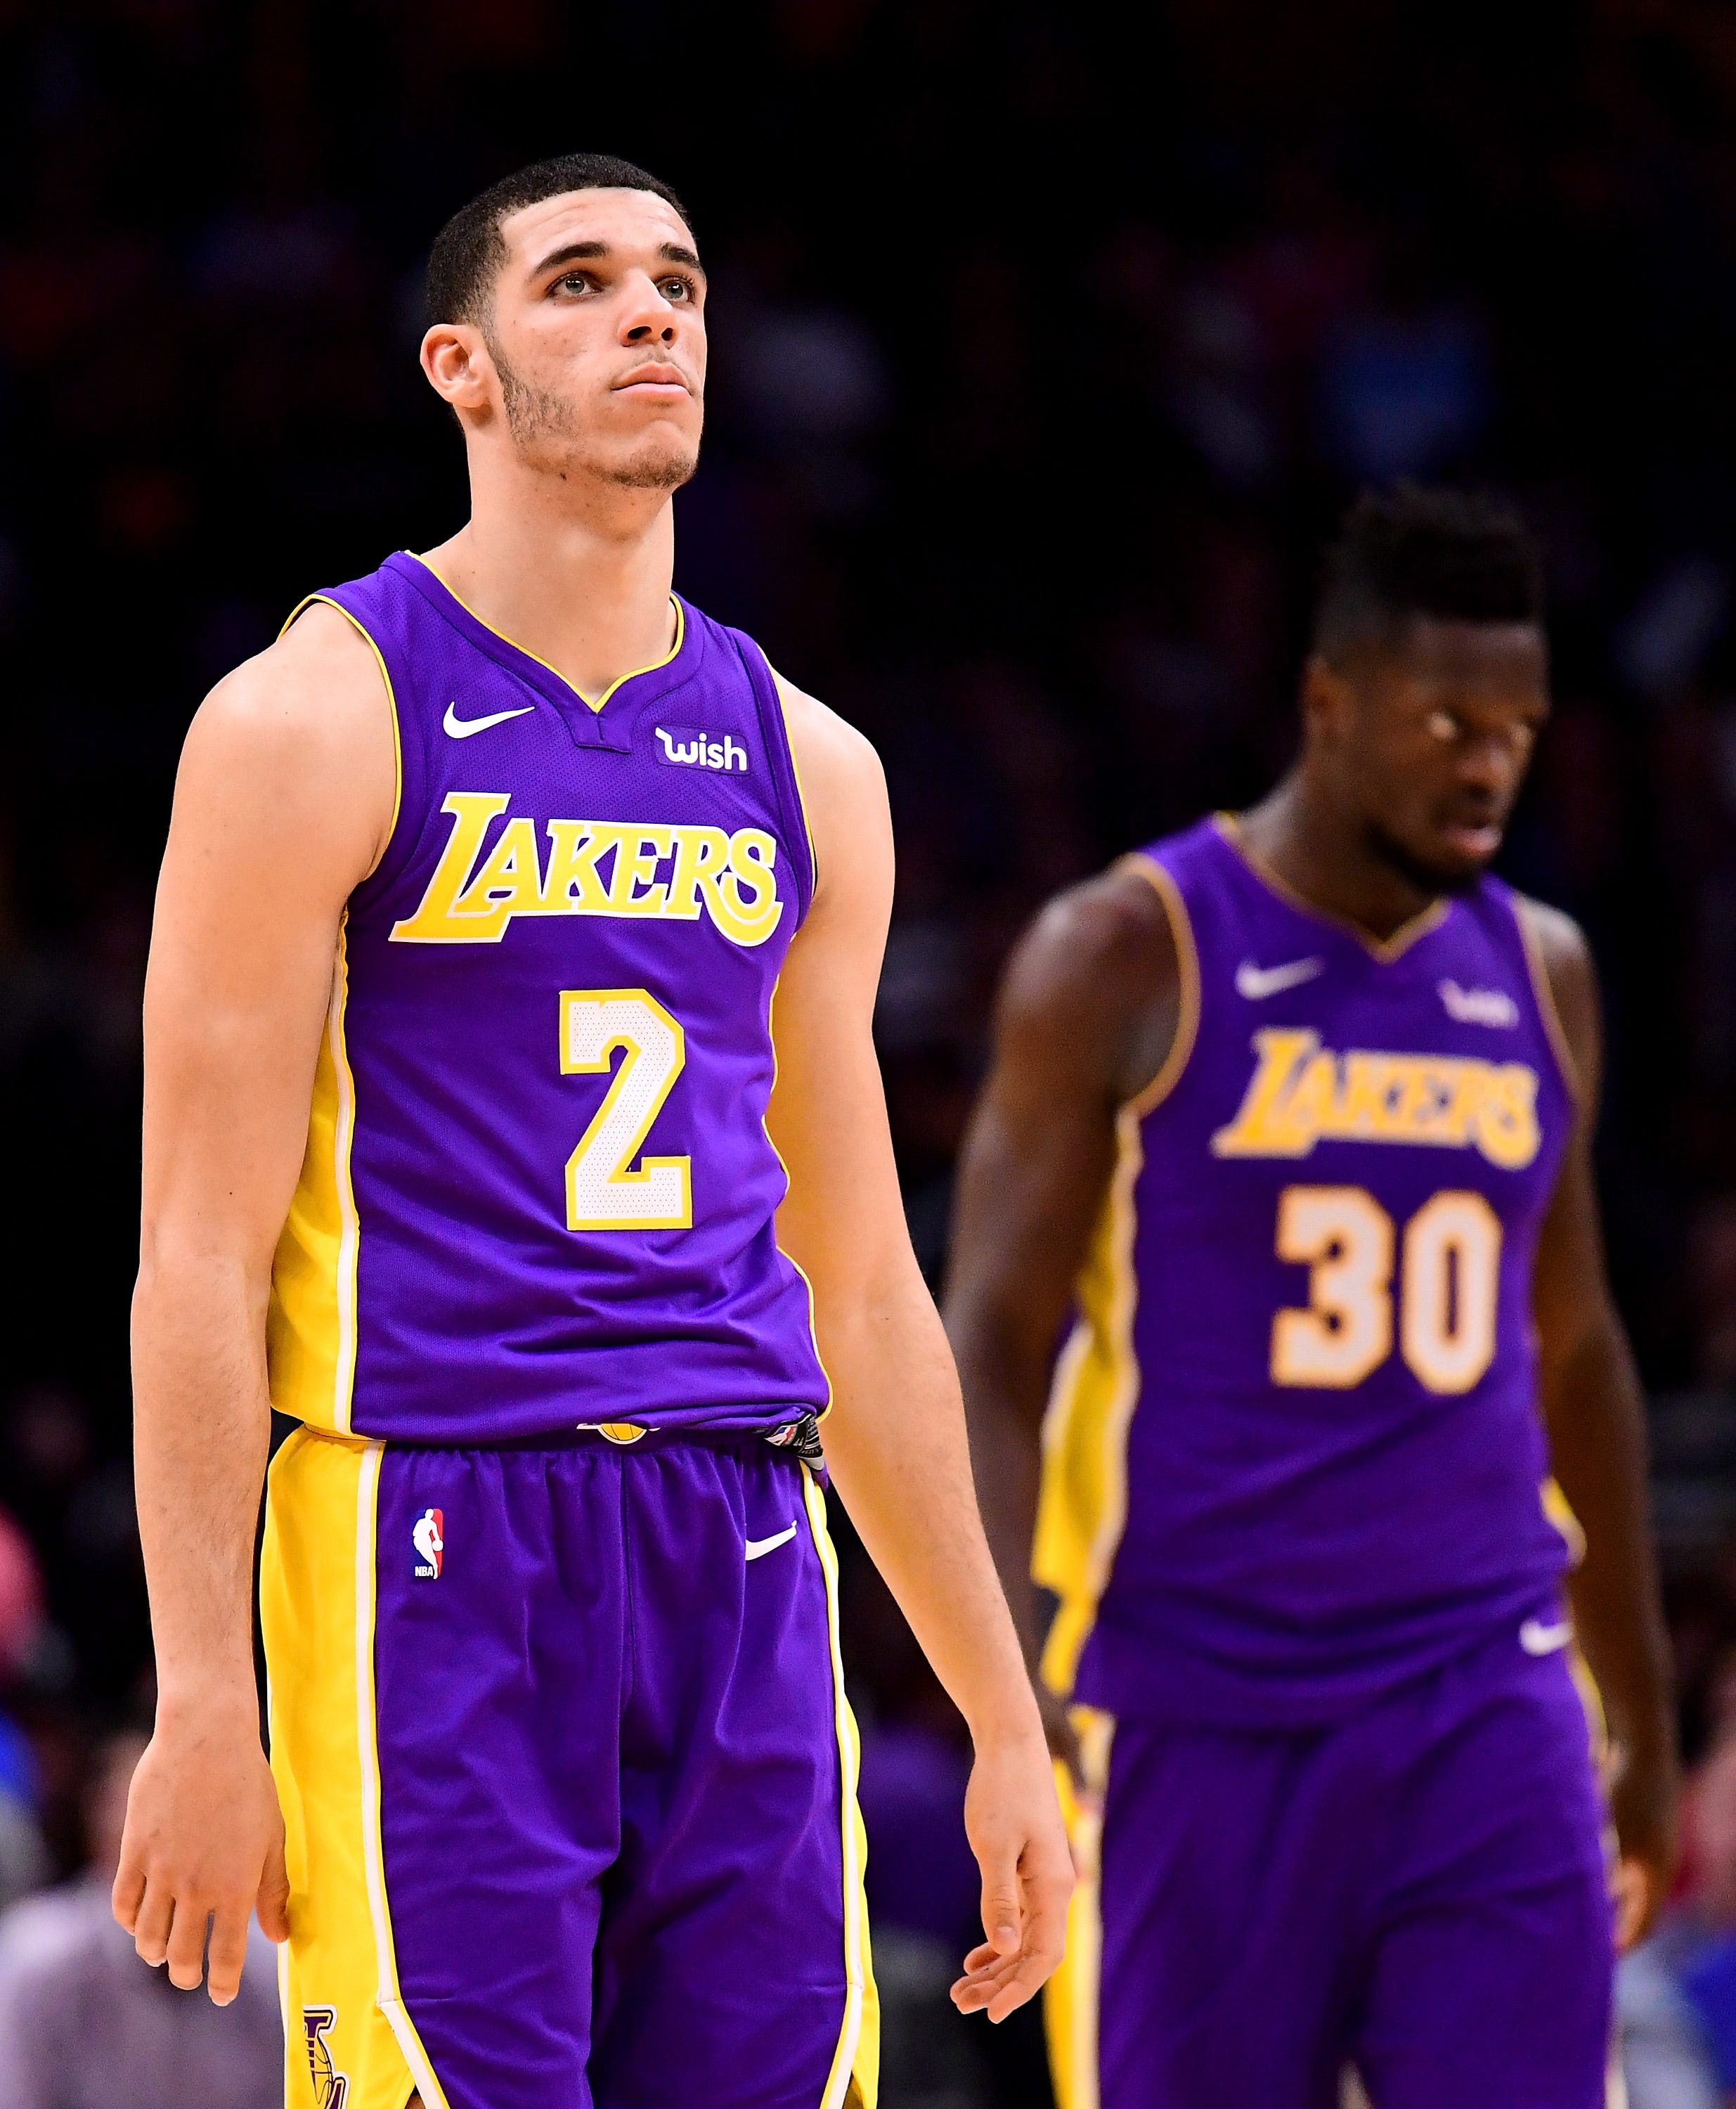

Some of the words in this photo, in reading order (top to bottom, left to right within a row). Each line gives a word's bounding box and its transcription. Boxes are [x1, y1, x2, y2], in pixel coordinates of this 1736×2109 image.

[654, 727, 748, 772] wish
[388, 792, 783, 947] LAKERS
[559, 989, 693, 1230] 2
[1212, 1026, 1540, 1170] LAKERS
[1271, 1184, 1503, 1395] 30
[415, 1566, 433, 1576] NBA
